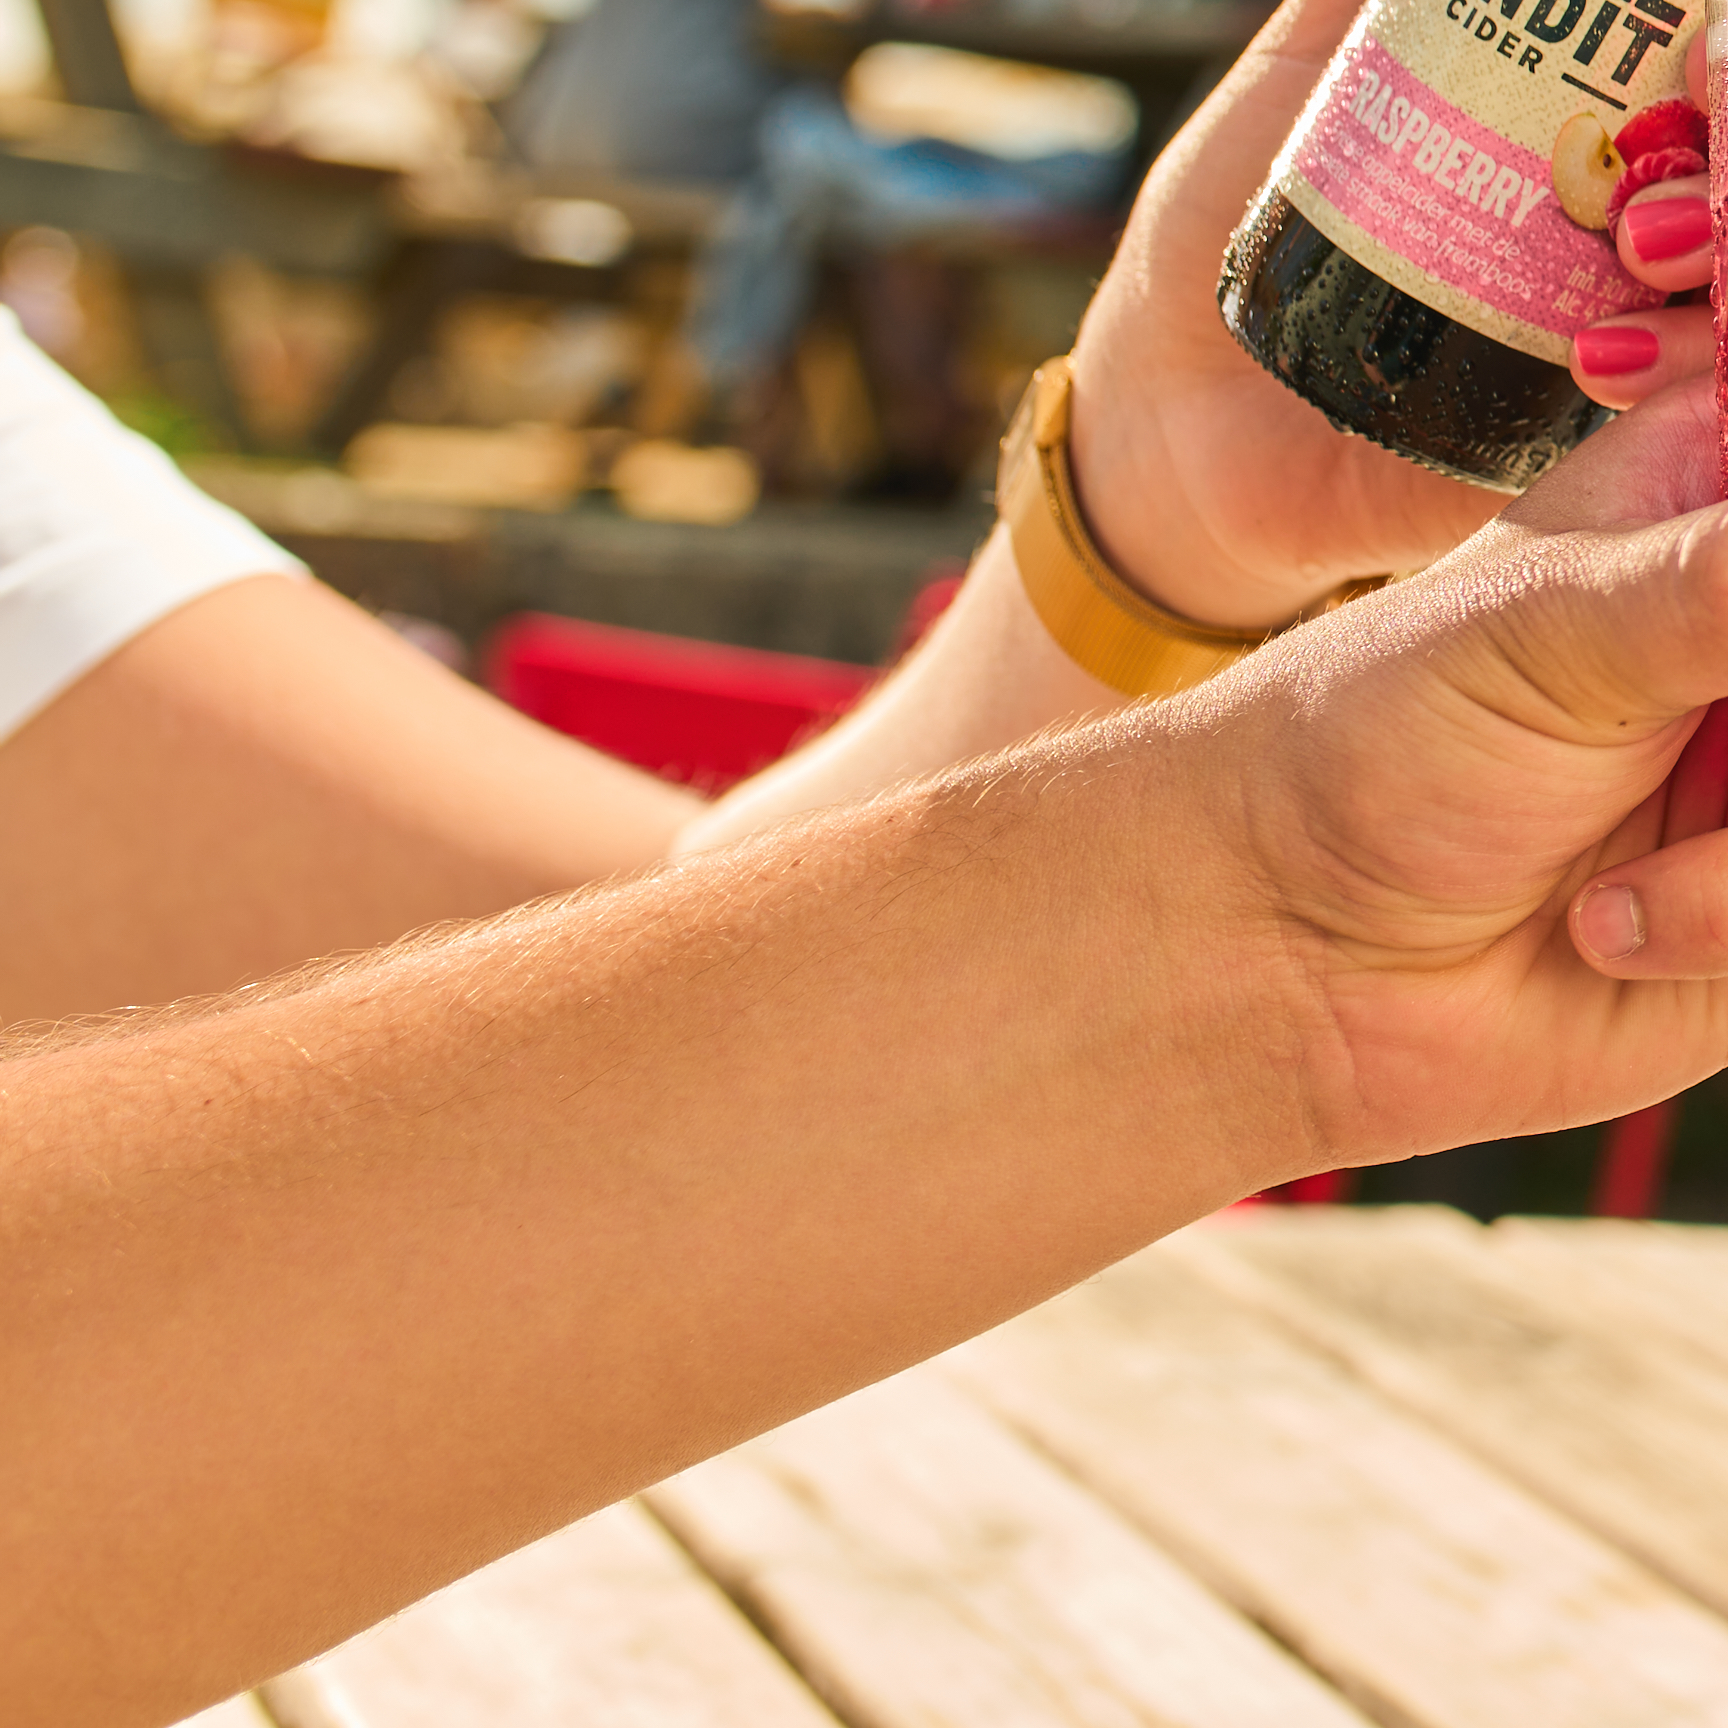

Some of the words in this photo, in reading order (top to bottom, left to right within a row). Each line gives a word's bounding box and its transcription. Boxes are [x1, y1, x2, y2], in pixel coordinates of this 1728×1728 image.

[1349, 69, 1550, 228] RASPBERRY
[1450, 215, 1494, 247] met
[1492, 236, 1521, 262] de
